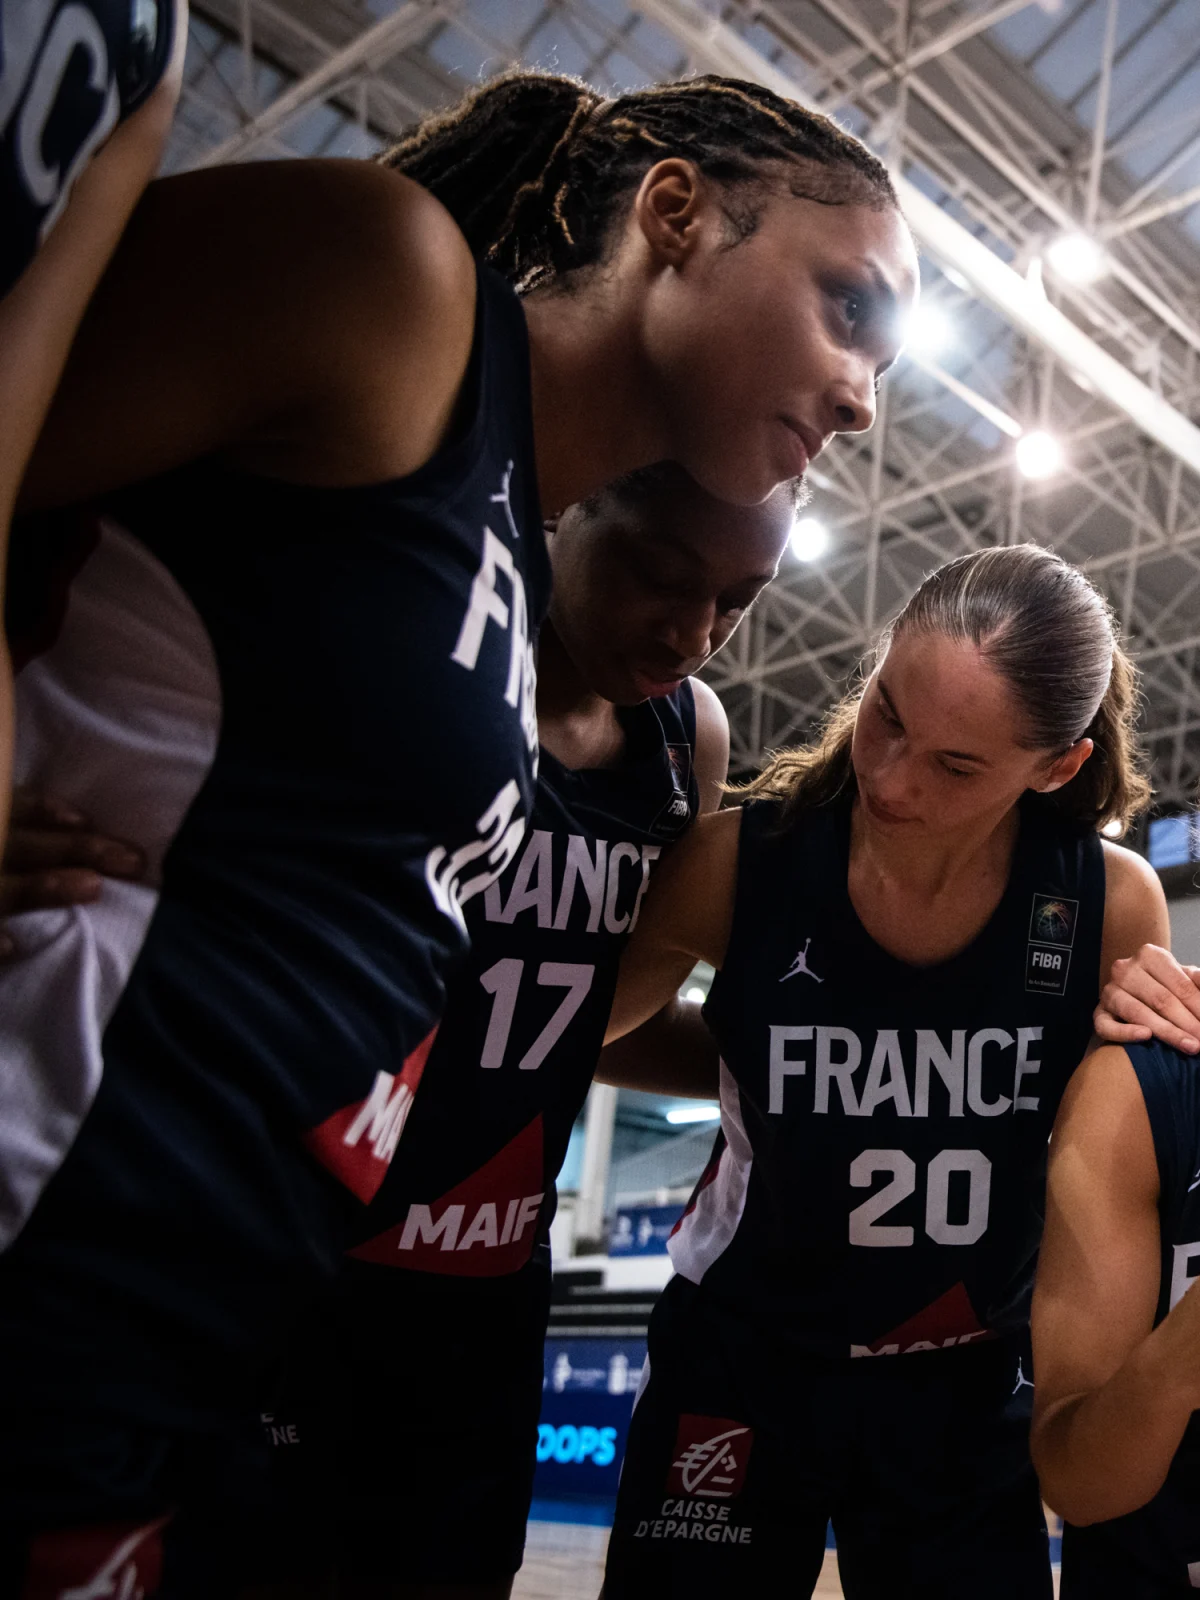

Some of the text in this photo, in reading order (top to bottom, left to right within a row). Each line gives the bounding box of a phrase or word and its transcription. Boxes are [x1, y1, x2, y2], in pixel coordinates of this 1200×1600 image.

[1032, 951, 1062, 970] FIBA
[479, 957, 596, 1070] 17
[767, 1025, 1044, 1118] FRANCE
[398, 1192, 546, 1252] MAIF
[849, 1149, 992, 1247] 20
[633, 1519, 753, 1544] D'EPARGNE
[660, 1498, 732, 1522] CAISSE
